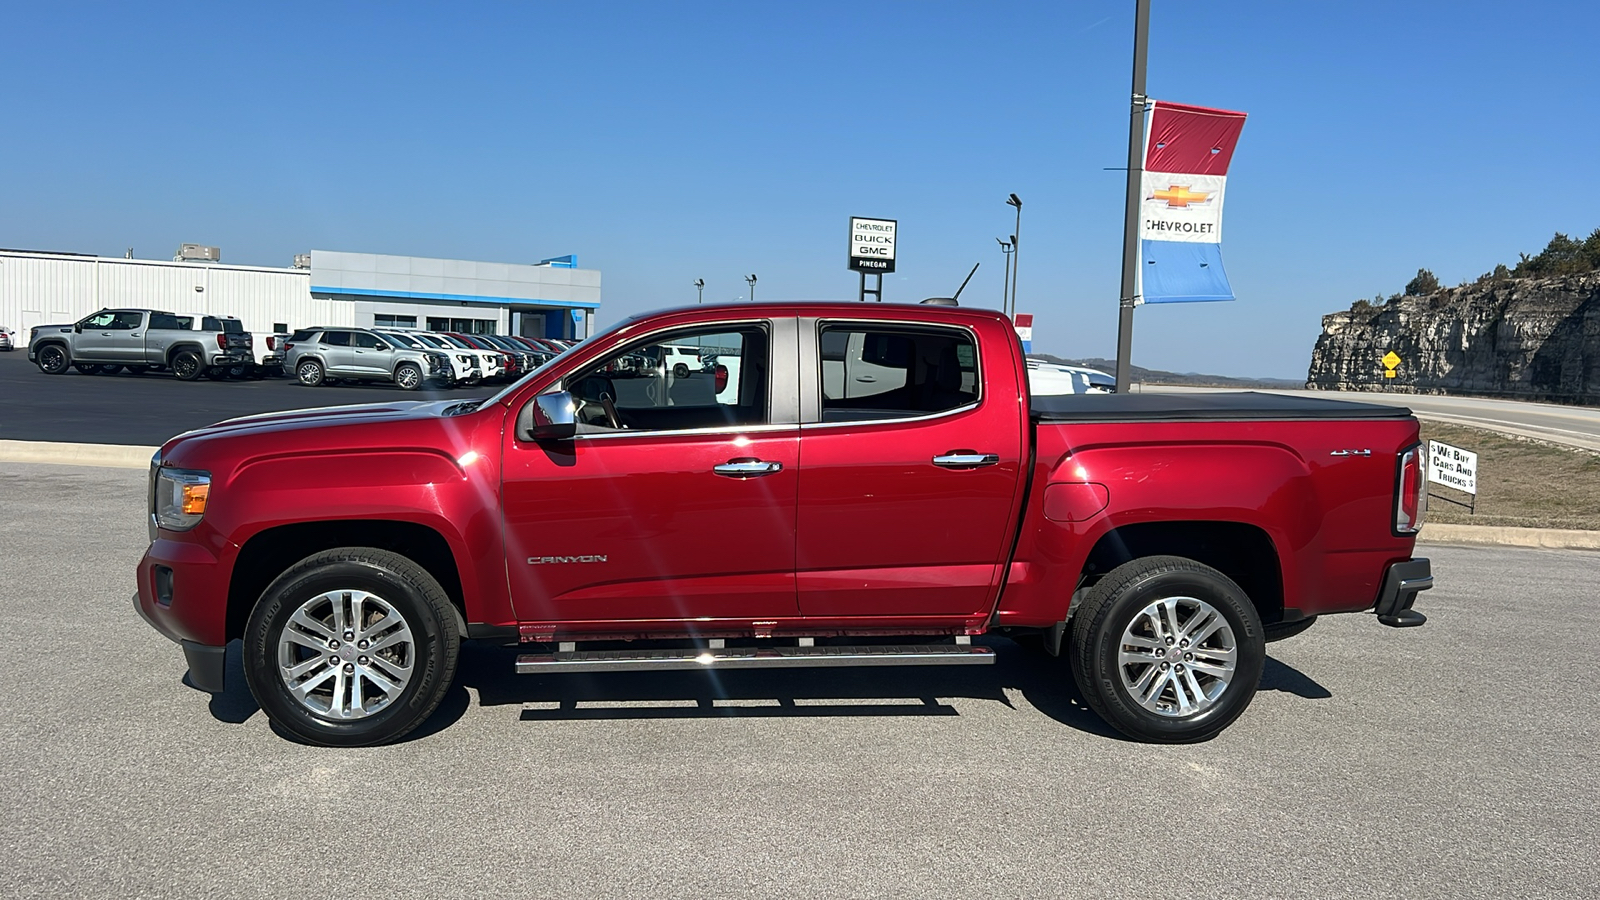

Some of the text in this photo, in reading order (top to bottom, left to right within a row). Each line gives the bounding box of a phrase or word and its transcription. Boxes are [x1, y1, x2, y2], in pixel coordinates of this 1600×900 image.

[855, 222, 893, 232] CHEVROLET
[855, 234, 892, 244] BUICK
[860, 246, 888, 255] GMC
[859, 260, 887, 268] PINEGAR
[527, 555, 607, 565] CANYON
[1226, 595, 1254, 636] MICHELIN
[257, 602, 279, 652] MICHELIN
